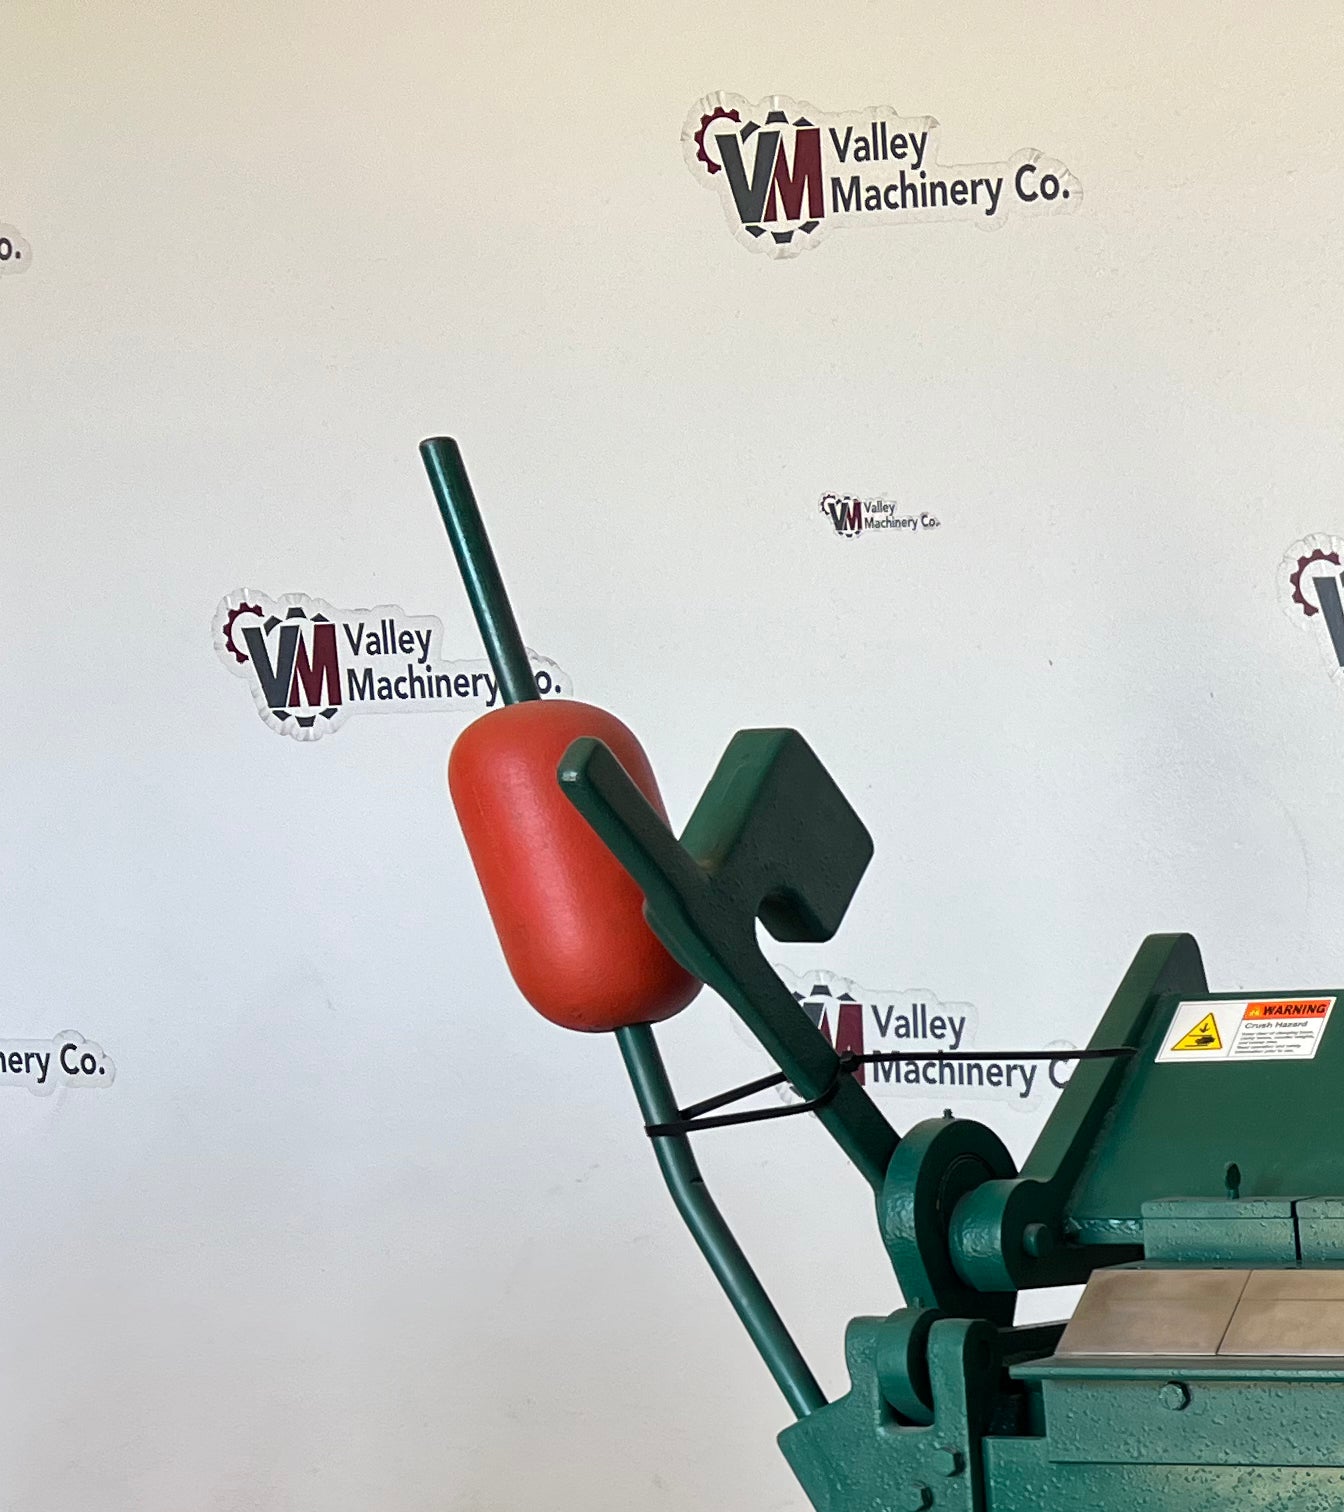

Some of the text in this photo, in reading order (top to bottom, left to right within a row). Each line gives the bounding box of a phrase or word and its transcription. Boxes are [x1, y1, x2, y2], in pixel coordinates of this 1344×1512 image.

[829, 122, 928, 170] Valley
[715, 127, 825, 224] VM
[831, 164, 1070, 215] Machinery Co.
[828, 502, 862, 531] VM
[864, 500, 896, 516] Valley
[864, 514, 941, 531] Machinery Co.
[343, 619, 432, 664] Valley
[241, 623, 342, 708] VM
[347, 664, 498, 707] Machinery
[872, 1003, 966, 1050] Valley
[1244, 1020, 1308, 1029] Crush Hazard
[1263, 1004, 1327, 1016] WARNING
[60, 1043, 105, 1075] Co.
[872, 1050, 1037, 1098] Machinery
